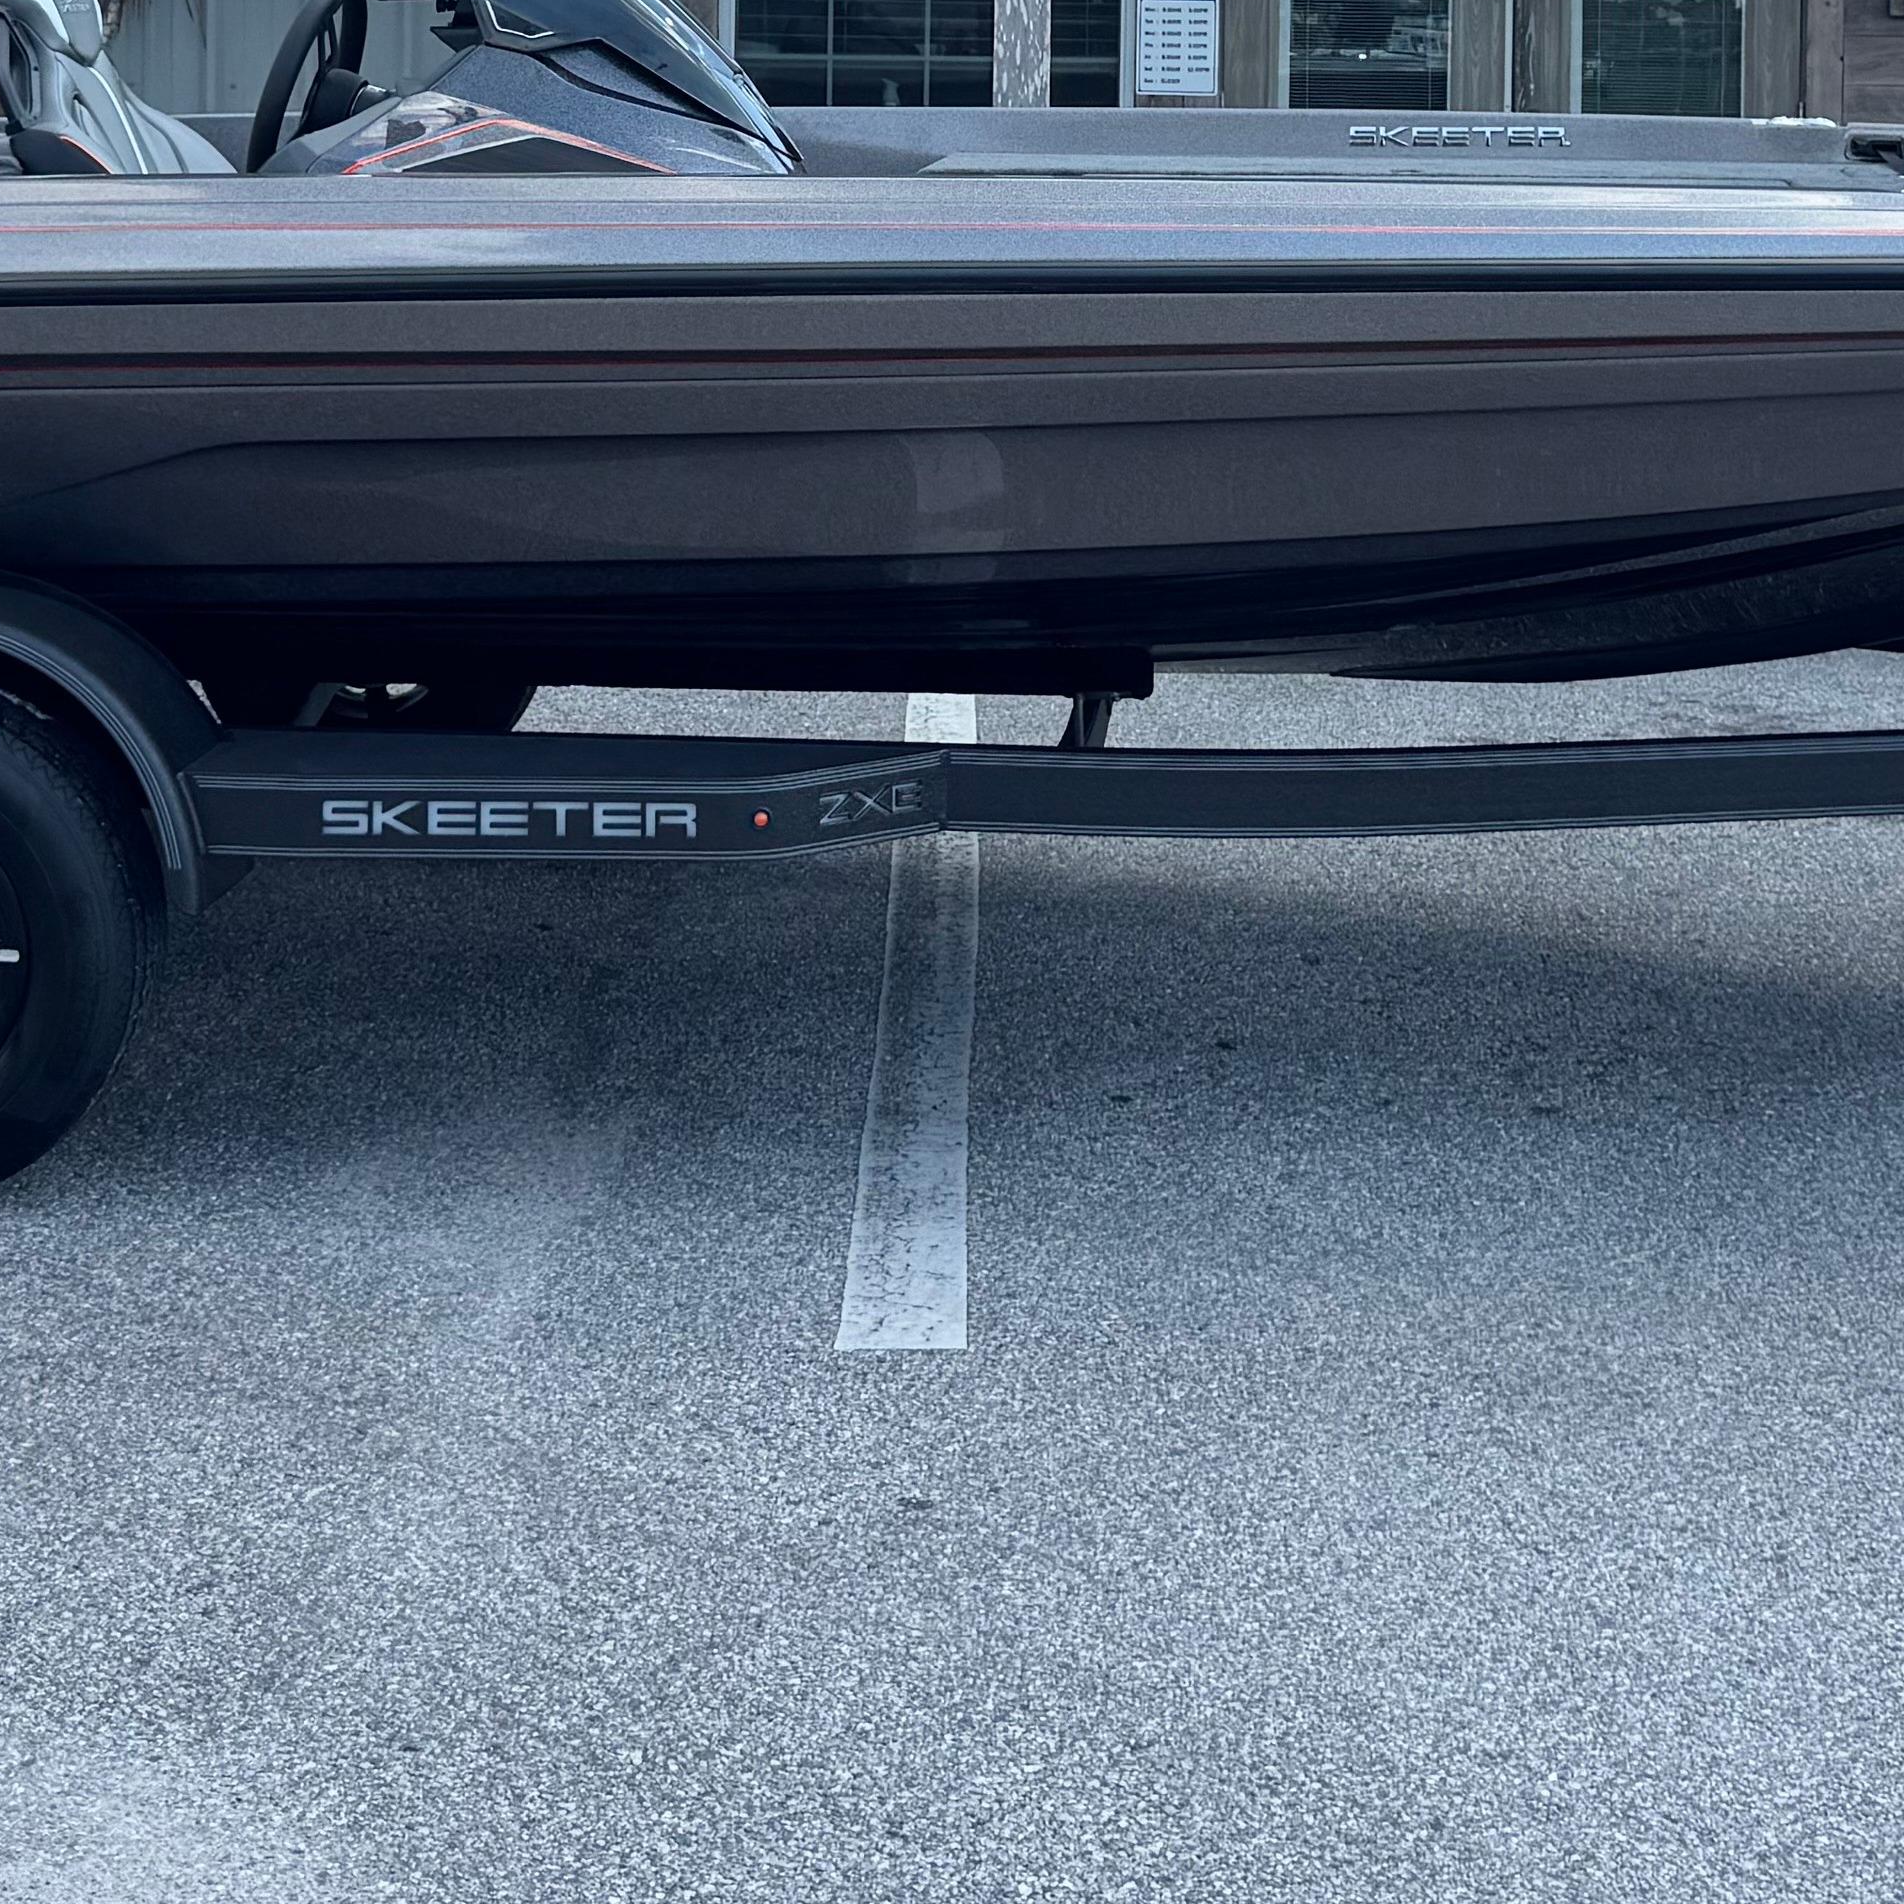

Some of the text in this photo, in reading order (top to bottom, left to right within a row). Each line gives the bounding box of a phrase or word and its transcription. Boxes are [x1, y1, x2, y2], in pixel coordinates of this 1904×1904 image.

[1349, 126, 1572, 146] SKEETER
[321, 801, 697, 838] SKEETER
[819, 780, 922, 826] ZXE
